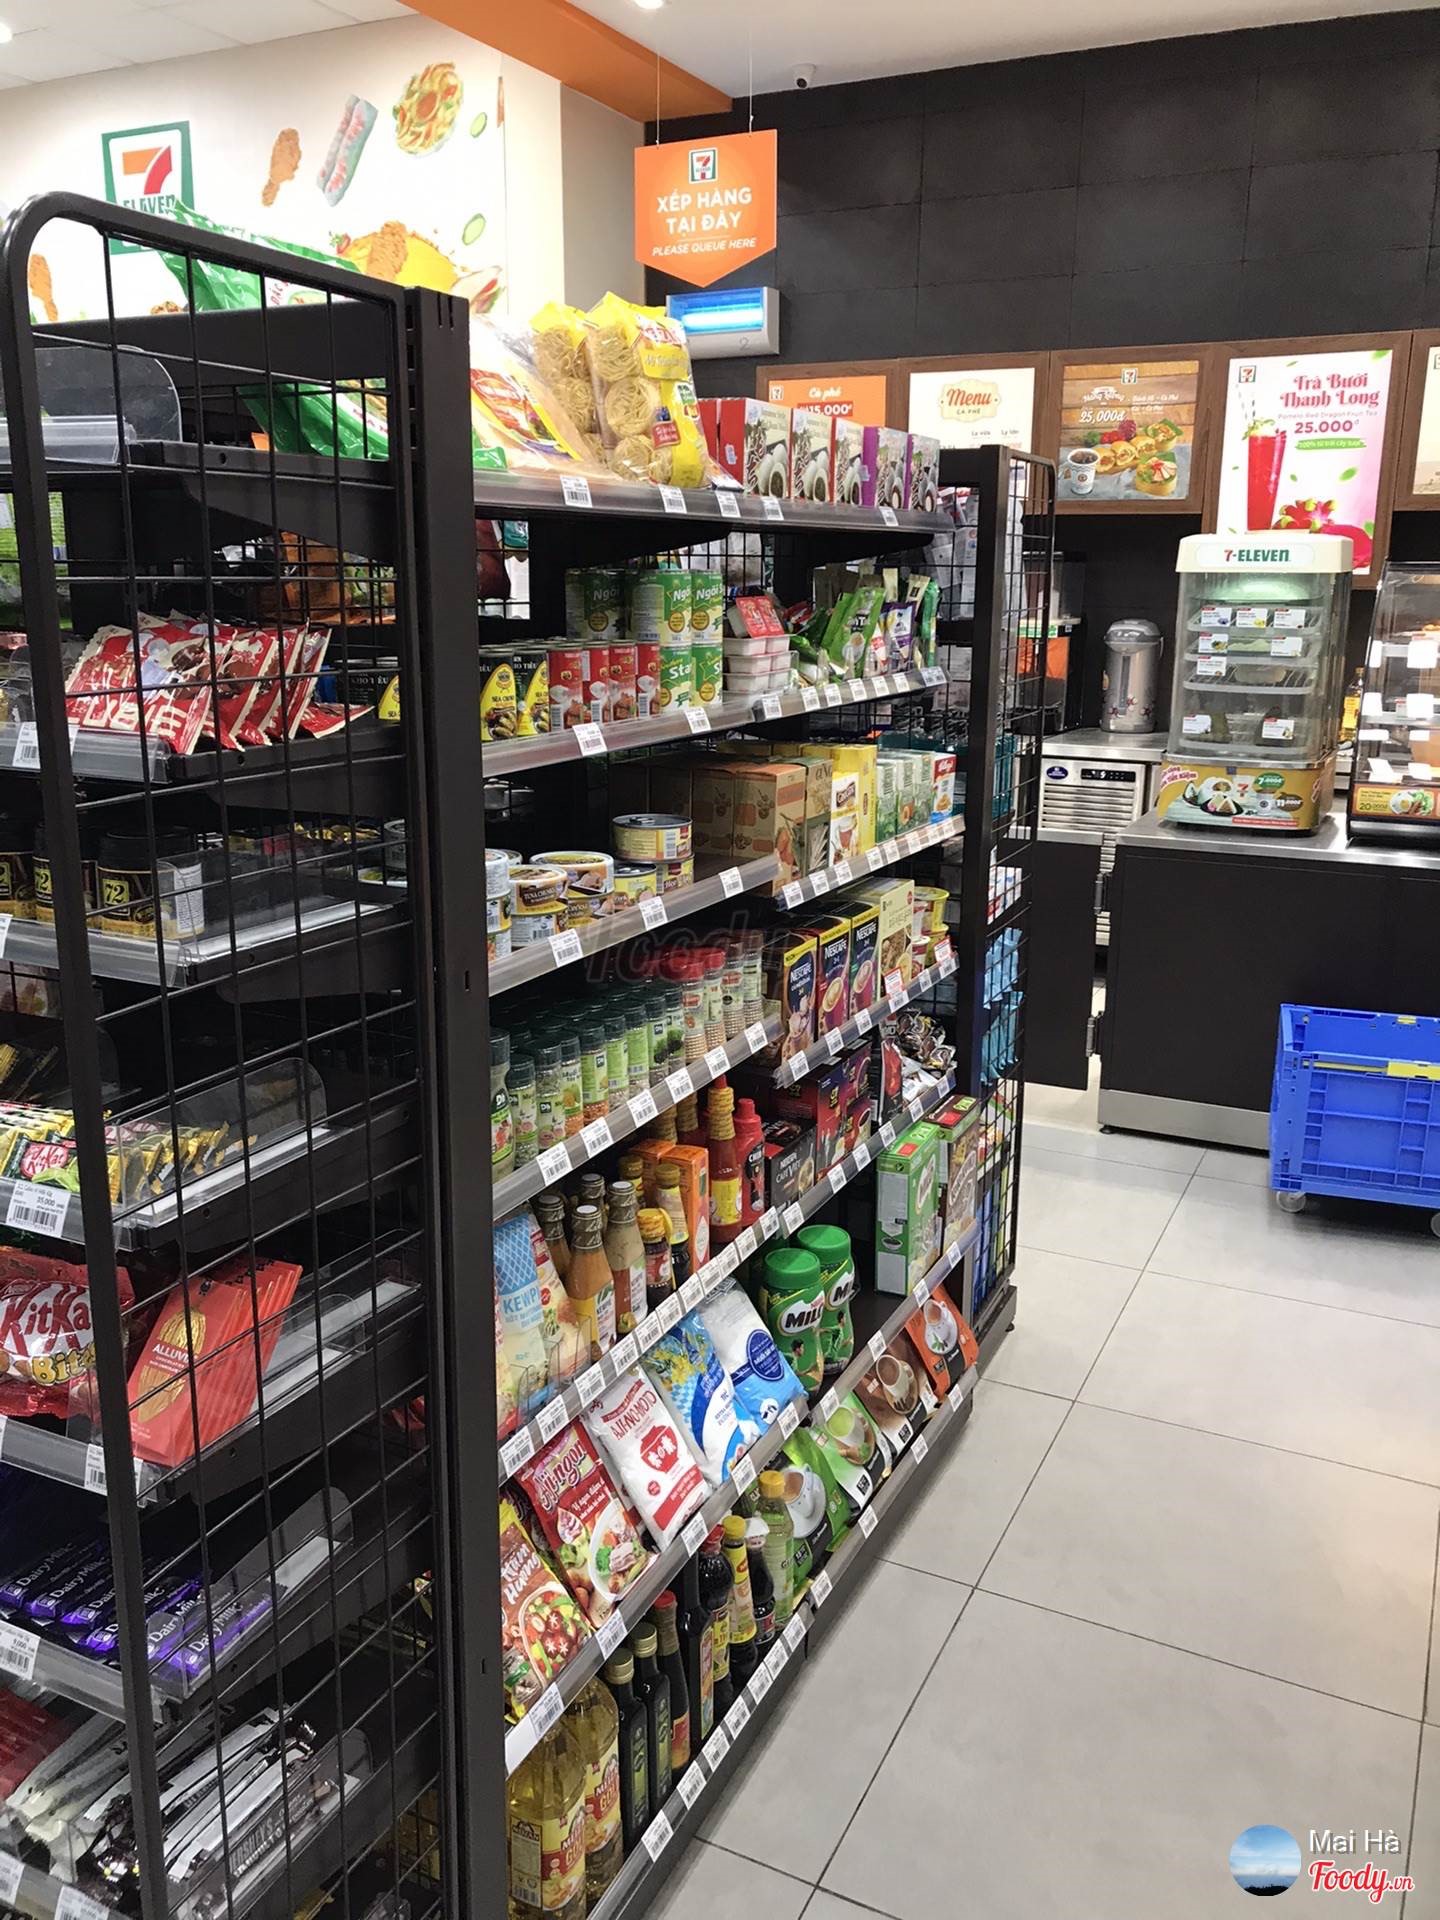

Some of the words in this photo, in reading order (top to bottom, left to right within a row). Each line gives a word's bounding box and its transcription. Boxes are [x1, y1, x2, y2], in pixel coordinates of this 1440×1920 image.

[697, 186, 752, 209] HÀNG
[666, 216, 696, 237] TẠI
[652, 243, 689, 256] PLEASE
[691, 240, 726, 253] QUEUE
[729, 237, 757, 248] HERE
[1294, 375, 1321, 390] Trà
[946, 388, 991, 407] Menu
[1280, 391, 1331, 408] Thanh
[1336, 389, 1381, 407] Long
[105, 883, 125, 904] 72
[0, 1282, 92, 1358] KitKa
[51, 1572, 82, 1599] Dairy
[90, 1587, 116, 1610] Dair
